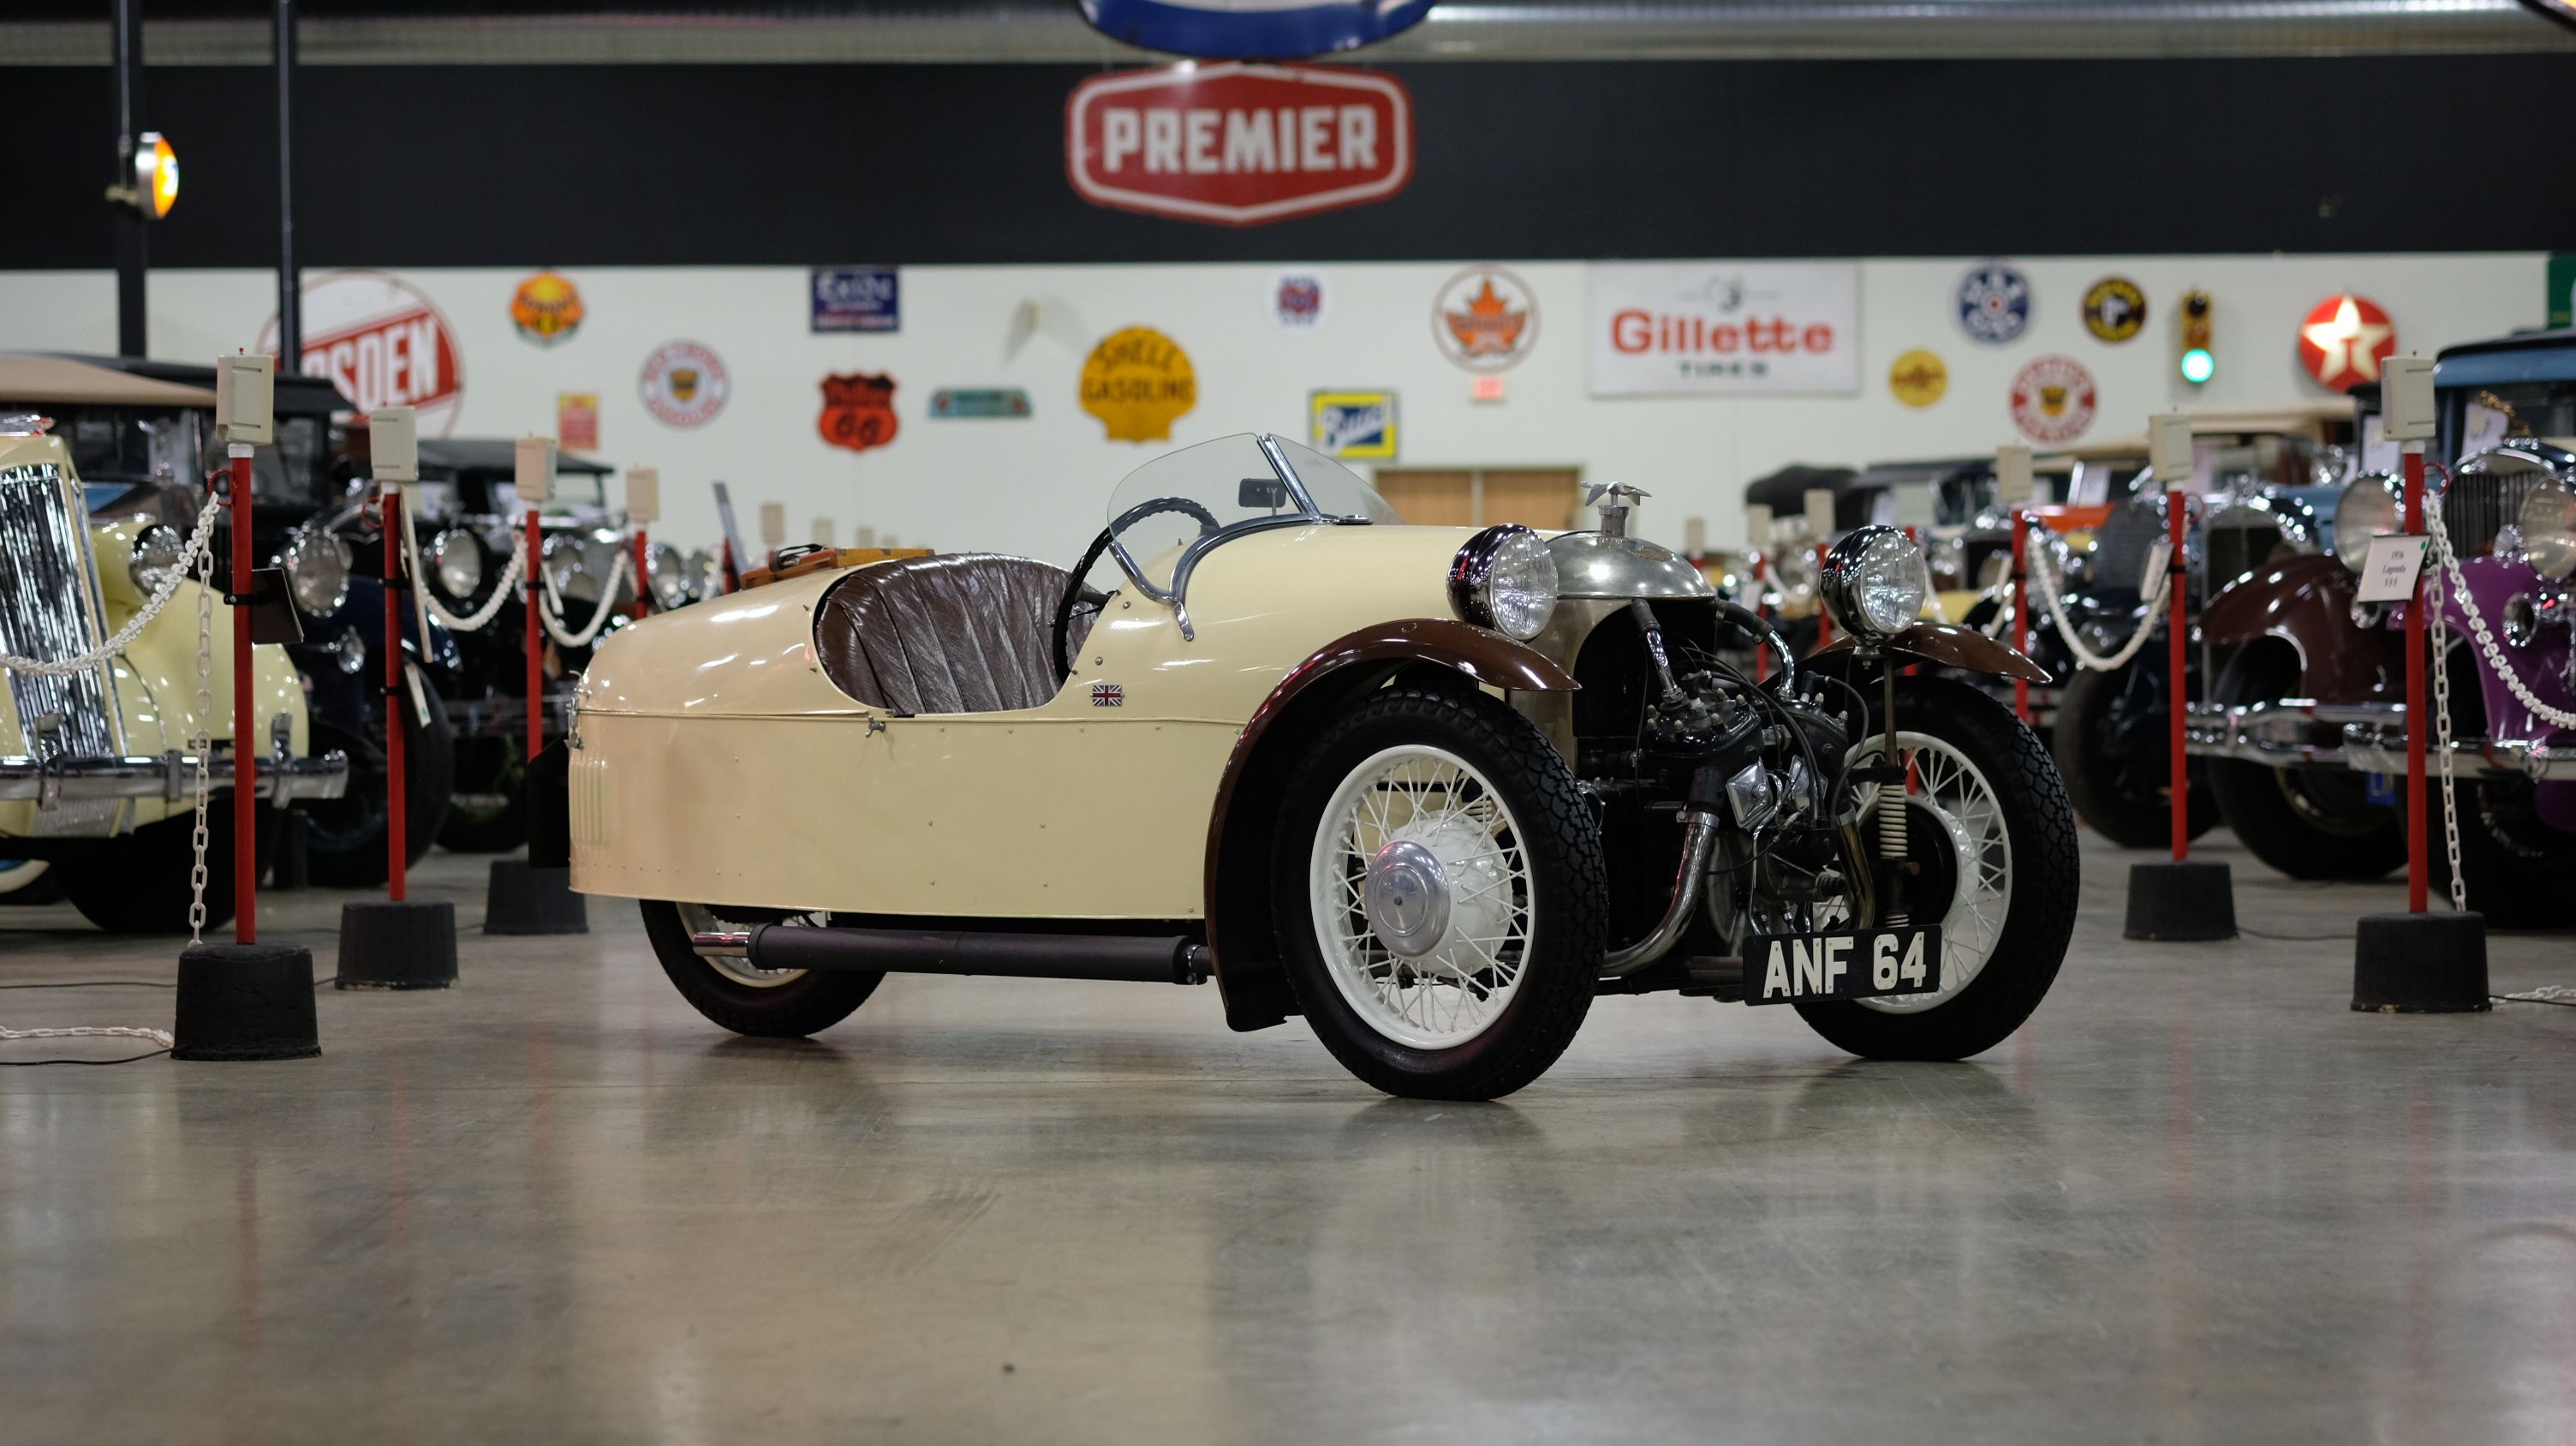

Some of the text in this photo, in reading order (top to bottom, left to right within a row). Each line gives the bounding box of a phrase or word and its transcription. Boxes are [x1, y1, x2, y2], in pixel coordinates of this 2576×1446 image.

[1102, 104, 1378, 174] PREMIER
[1610, 308, 1835, 356] Gillette
[1096, 338, 1176, 373] SHELL
[1081, 377, 1194, 403] GASOLINE
[833, 412, 881, 445] 66
[1762, 931, 1927, 999] ANF 64
